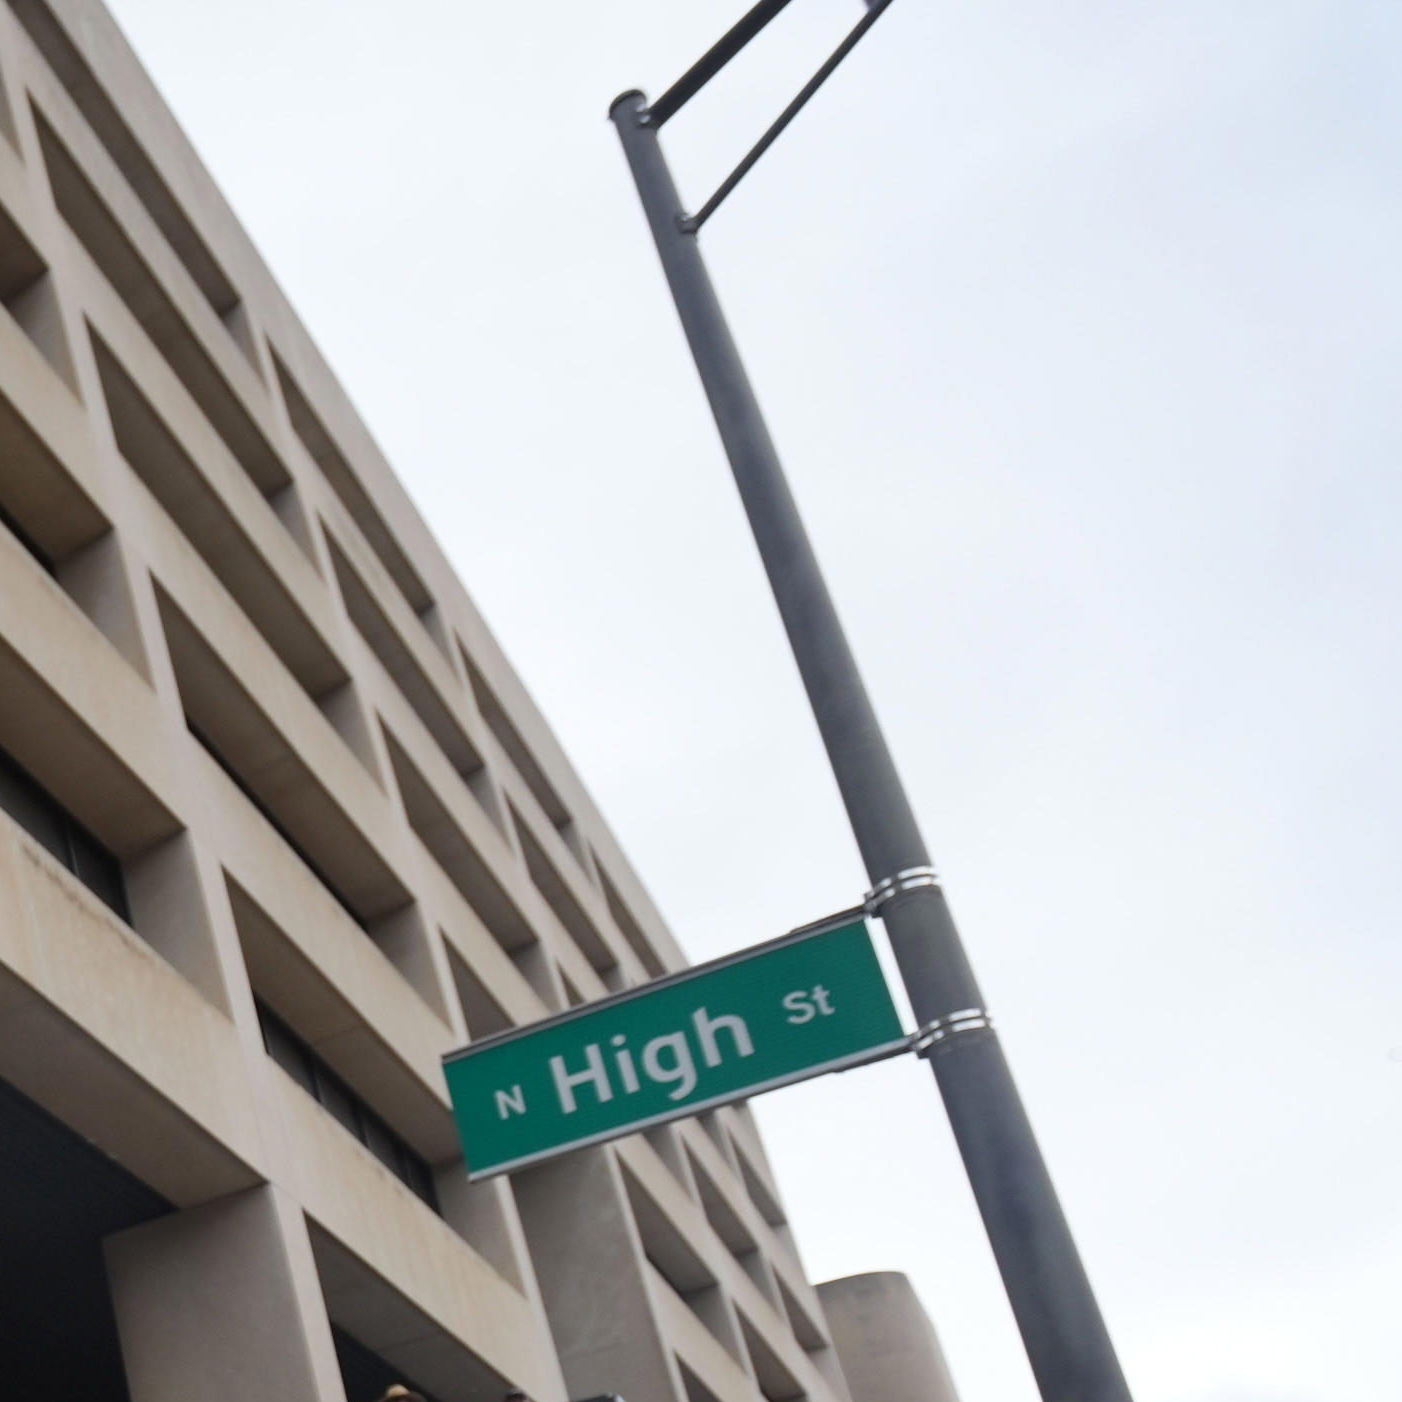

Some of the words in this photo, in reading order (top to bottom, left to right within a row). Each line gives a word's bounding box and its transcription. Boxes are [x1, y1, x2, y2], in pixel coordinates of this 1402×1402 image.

[494, 1084, 526, 1121] N
[548, 1007, 756, 1115] High
[782, 983, 836, 1025] St
